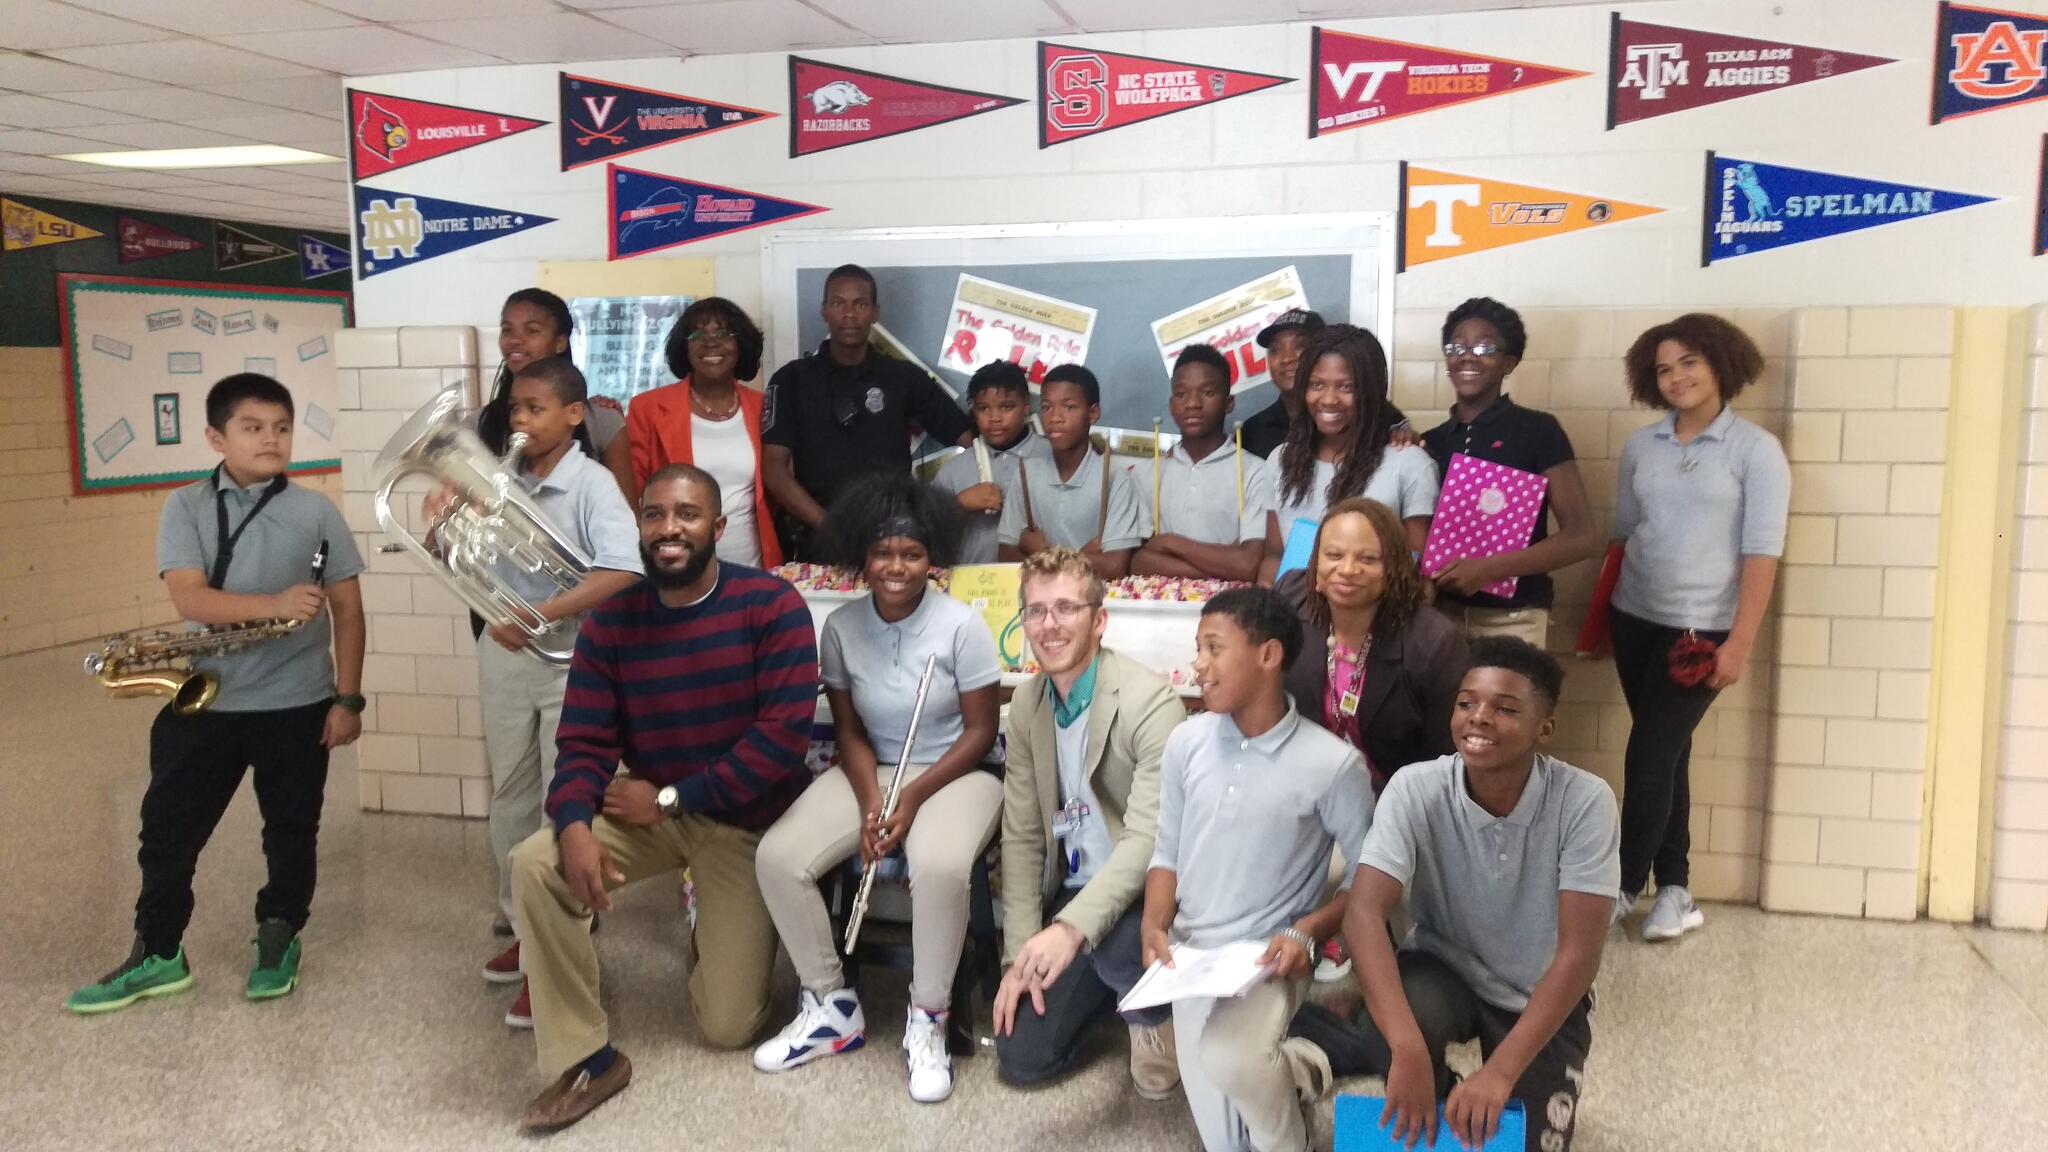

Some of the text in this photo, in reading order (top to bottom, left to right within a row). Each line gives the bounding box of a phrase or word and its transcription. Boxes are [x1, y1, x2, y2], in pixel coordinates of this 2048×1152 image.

[1706, 48, 1793, 63] TEXAS A&M
[1408, 63, 1492, 76] VIRGINIA TECH
[1704, 66, 1791, 87] AGGIES
[1117, 71, 1198, 89] NC STATE
[1323, 61, 1408, 103] VT
[1407, 75, 1490, 95] HOKIES
[1115, 86, 1204, 105] WOLFPACK
[583, 96, 617, 131] V
[652, 106, 695, 115] UNIVERSITY
[696, 106, 708, 114] OF
[637, 114, 708, 131] VIRGINIA
[803, 118, 871, 132] RAZORBACKS
[417, 124, 487, 140] LOUISVILLE
[1785, 191, 1935, 218] SPELMAN
[1409, 184, 1481, 247] T
[38, 220, 75, 239] LSU
[424, 218, 469, 234] NOTRE
[1714, 220, 1784, 235] JAGUARS
[957, 309, 984, 330] The
